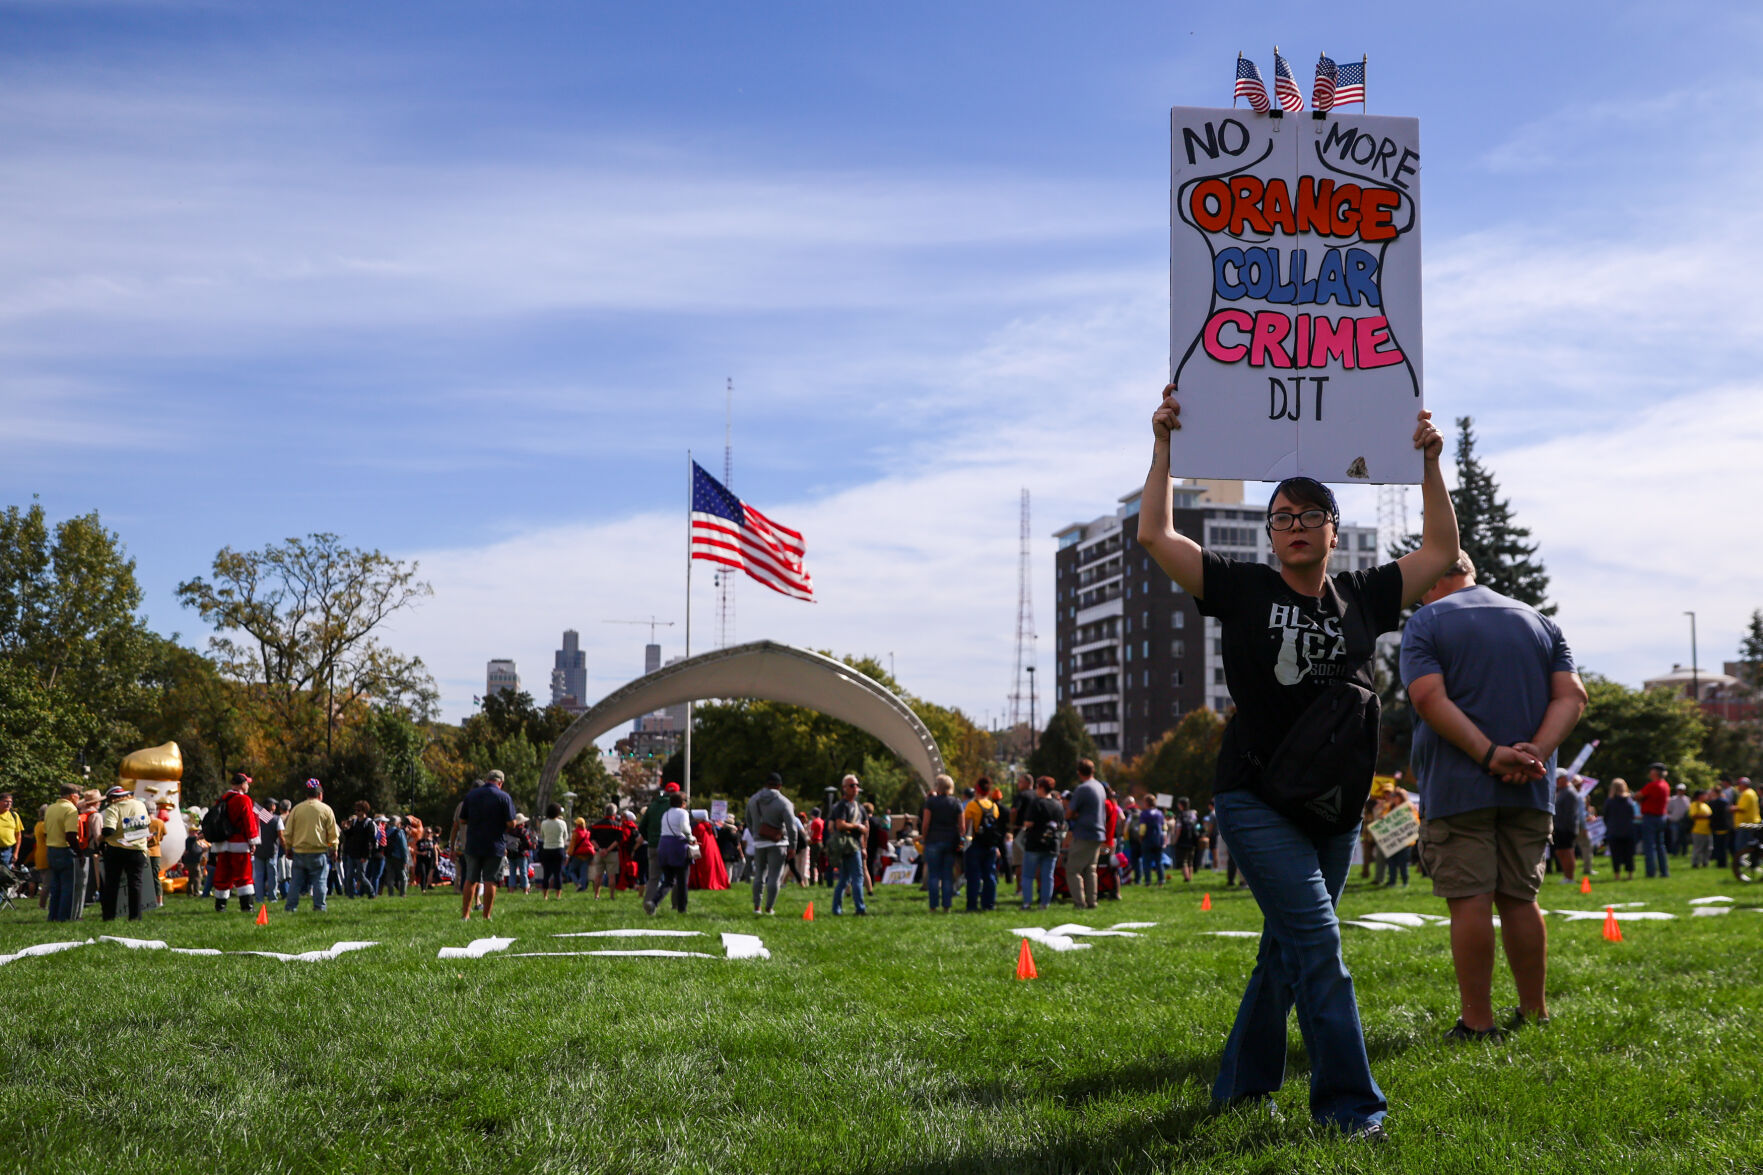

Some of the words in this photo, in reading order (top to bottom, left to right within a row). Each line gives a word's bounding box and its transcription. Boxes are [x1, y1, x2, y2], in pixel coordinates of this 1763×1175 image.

[1183, 119, 1250, 164] NO
[1322, 122, 1420, 189] MORE
[1190, 175, 1401, 241] ORANGE
[1214, 247, 1381, 306] COLLAR
[1202, 308, 1404, 370] CRIME
[1268, 376, 1330, 421] DJT
[1268, 602, 1344, 638] BLC
[1302, 631, 1347, 660] CA
